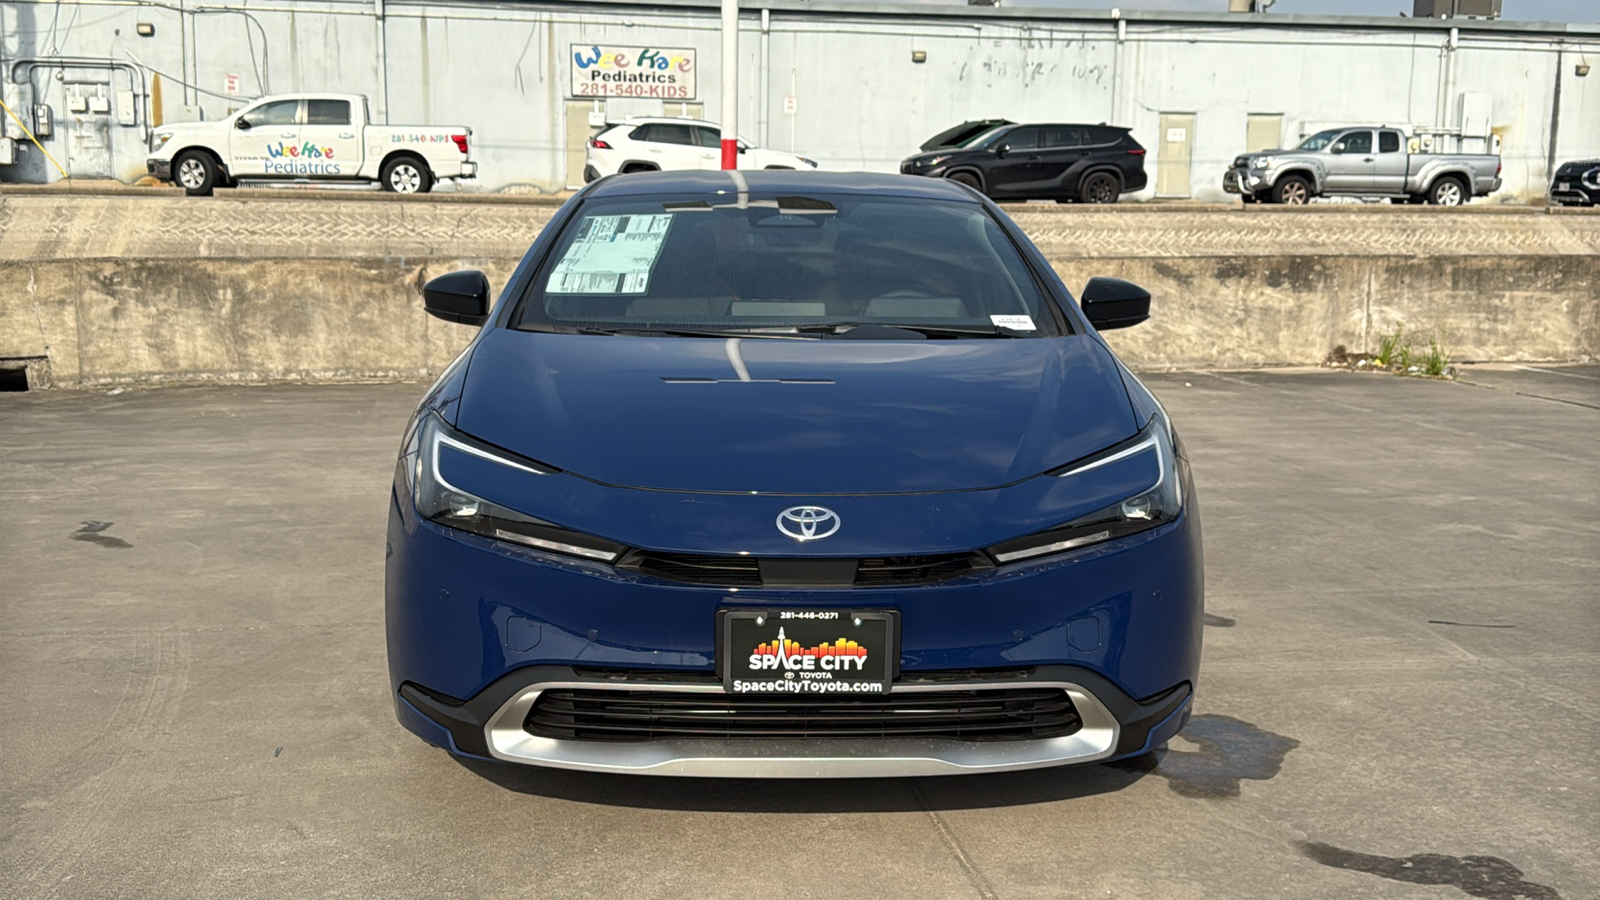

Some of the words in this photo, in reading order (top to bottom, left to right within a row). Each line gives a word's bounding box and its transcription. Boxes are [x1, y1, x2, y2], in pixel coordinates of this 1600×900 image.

[574, 45, 630, 69] Wee
[637, 48, 692, 73] Kare
[591, 70, 677, 83] Pediatrics
[580, 82, 688, 98] 281-540-KIDS
[267, 141, 300, 159] Wee
[265, 159, 341, 174] Pediatrics
[780, 611, 839, 619] 281-446-0271
[749, 654, 815, 670] SPACE
[820, 655, 868, 670] CITY
[733, 680, 883, 693] SpaceCityToyota.com
